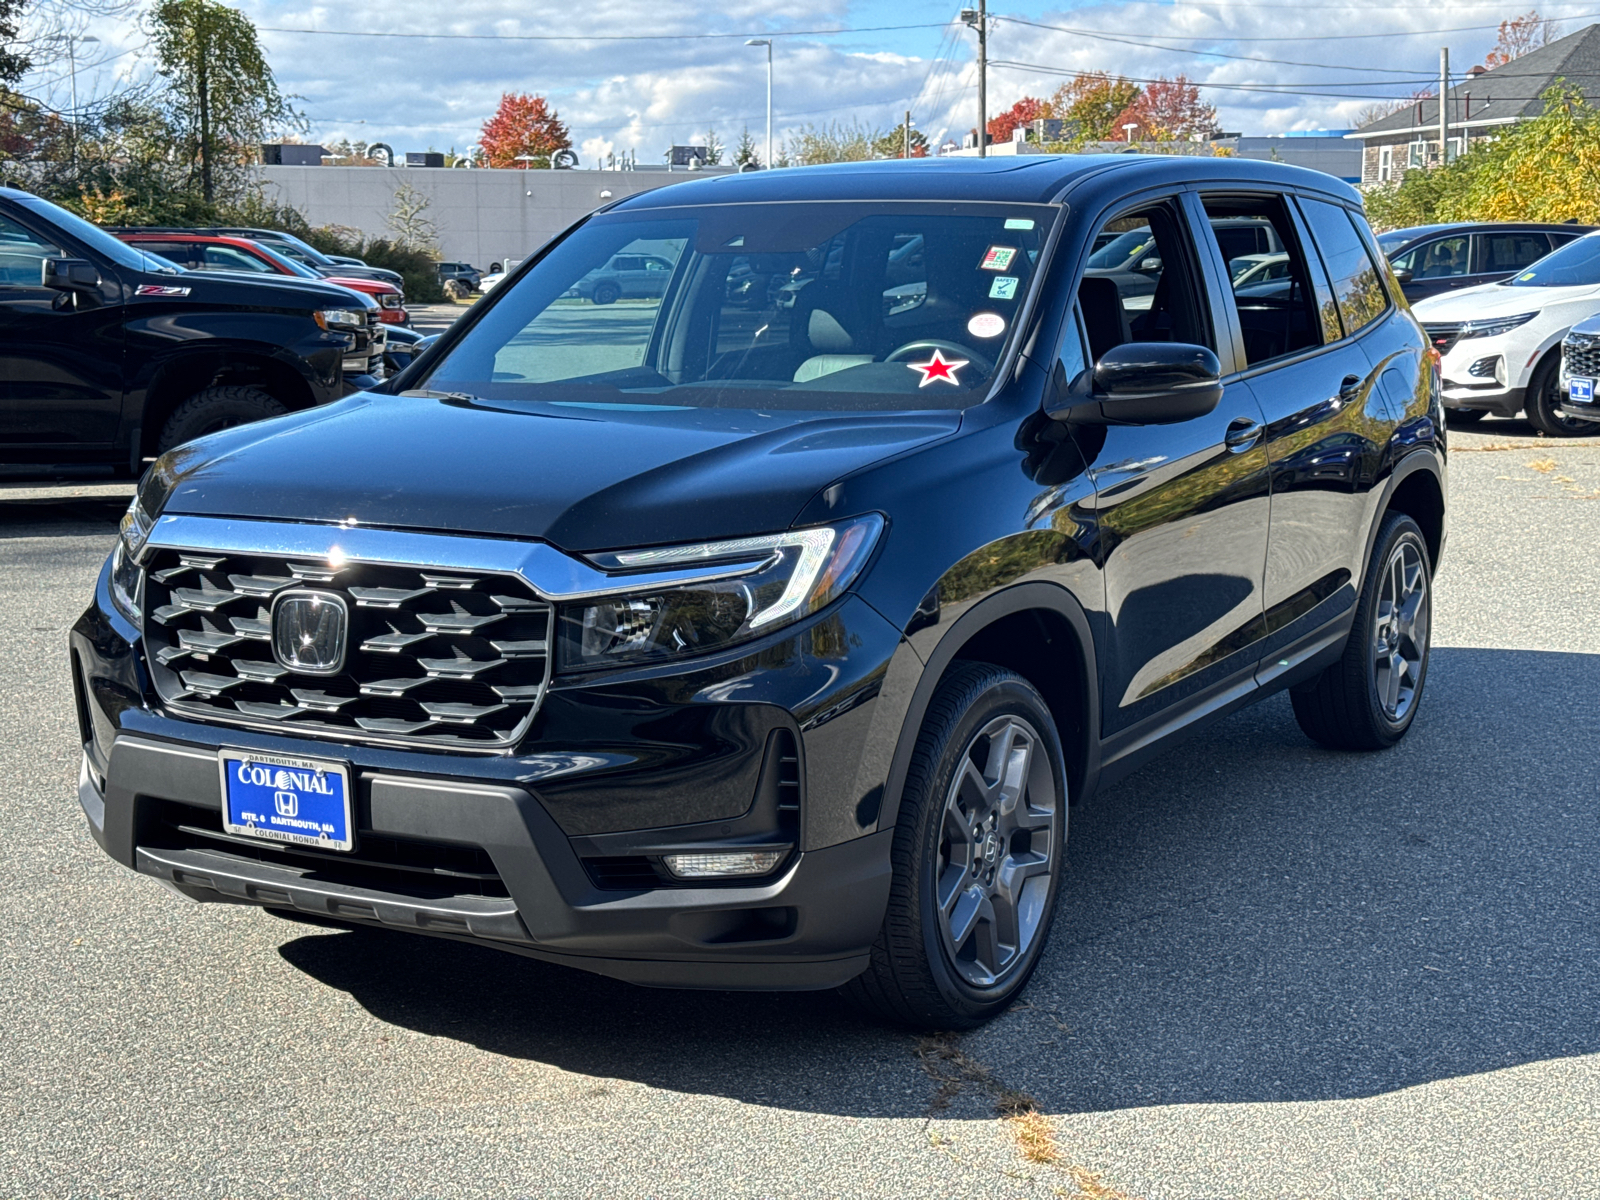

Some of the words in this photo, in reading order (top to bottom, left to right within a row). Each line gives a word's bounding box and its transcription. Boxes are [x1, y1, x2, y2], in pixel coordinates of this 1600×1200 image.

[134, 284, 192, 298] Z71
[301, 761, 315, 769] MA
[237, 763, 334, 795] COLONIAL
[241, 812, 259, 822] RTE.
[259, 814, 266, 823] 6
[270, 816, 321, 832] DARTMOUTH,
[322, 823, 335, 833] MA
[254, 829, 291, 841] COLONIAL
[292, 833, 320, 846] HONDA
